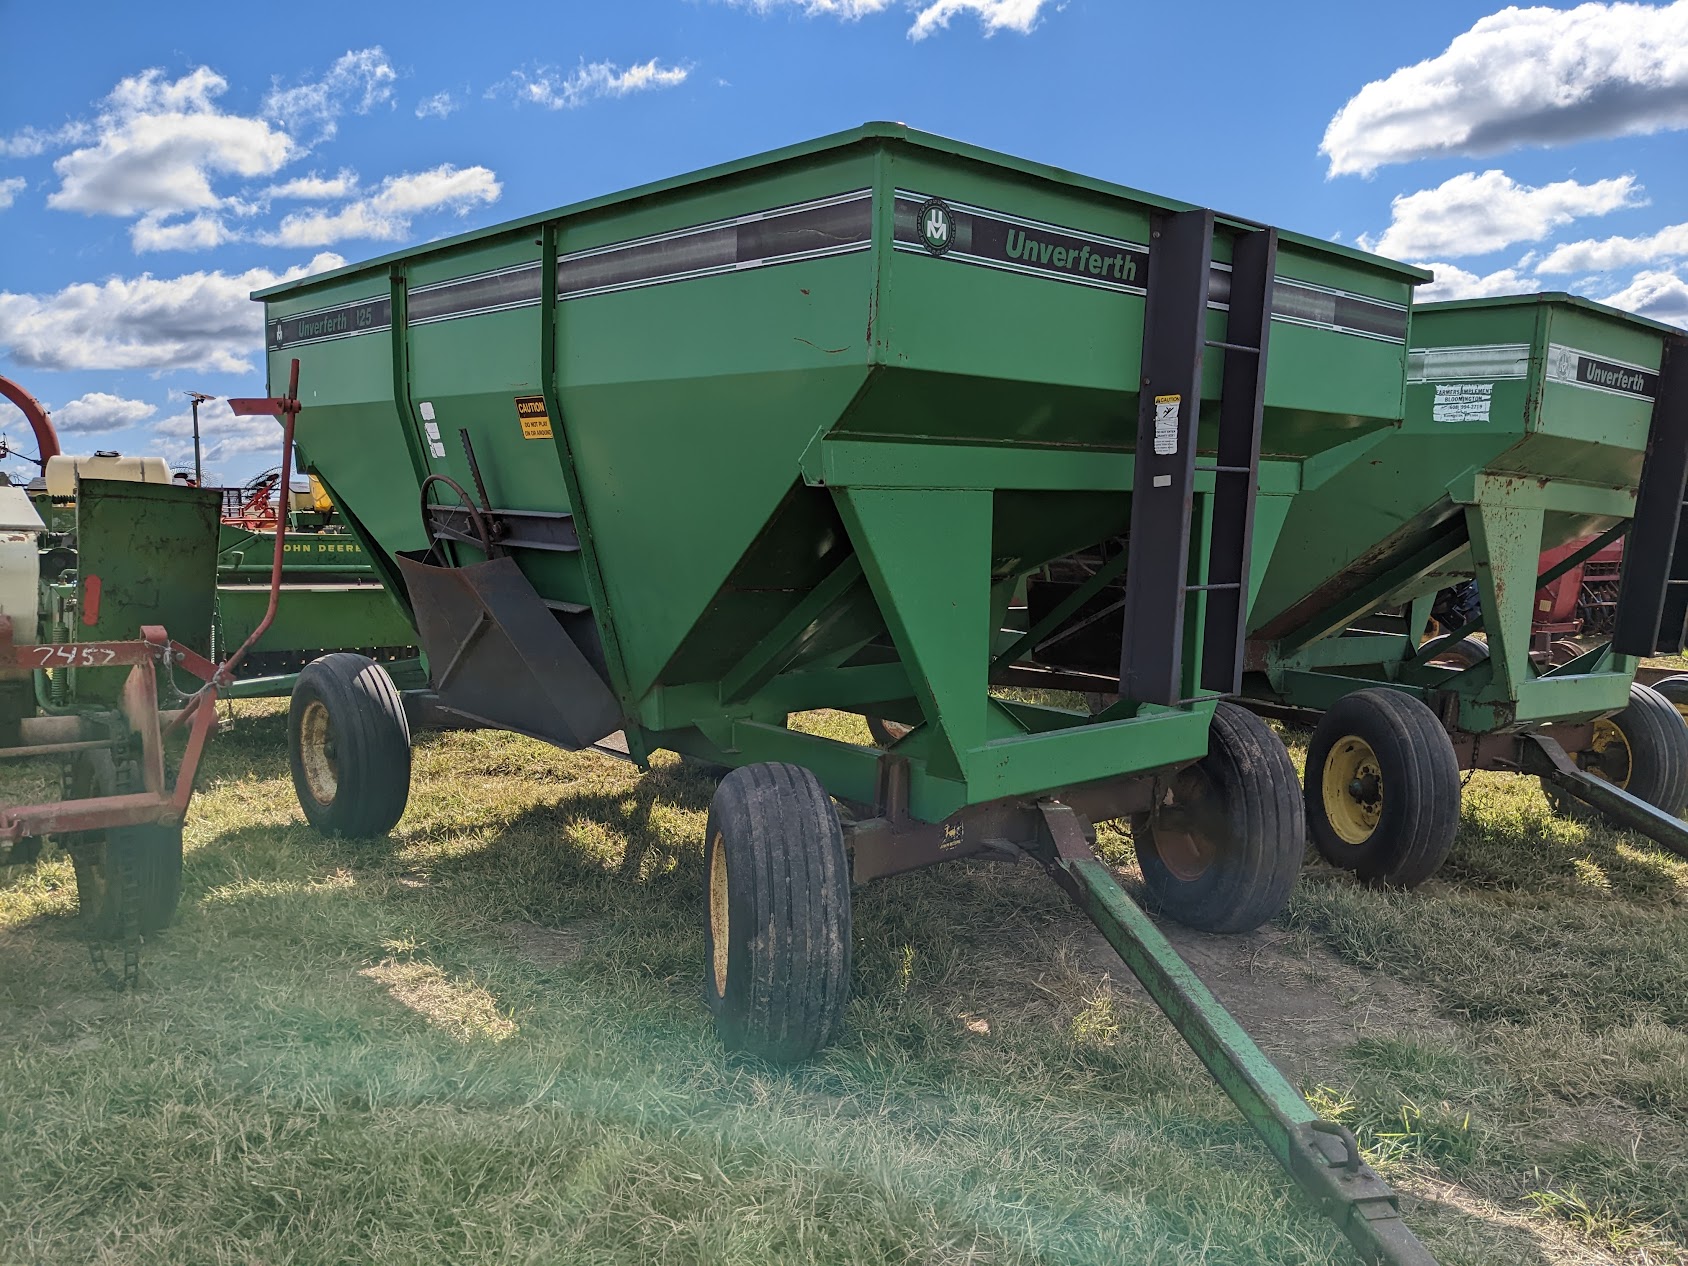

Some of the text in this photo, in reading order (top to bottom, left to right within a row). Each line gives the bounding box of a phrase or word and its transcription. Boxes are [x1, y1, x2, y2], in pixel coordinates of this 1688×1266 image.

[1005, 229, 1137, 281] Unverferth
[299, 312, 347, 338] Unverferth
[1586, 362, 1645, 392] Unverferth
[518, 401, 546, 414] CAUTION
[282, 544, 311, 553] OHN
[33, 646, 116, 666] 7457
